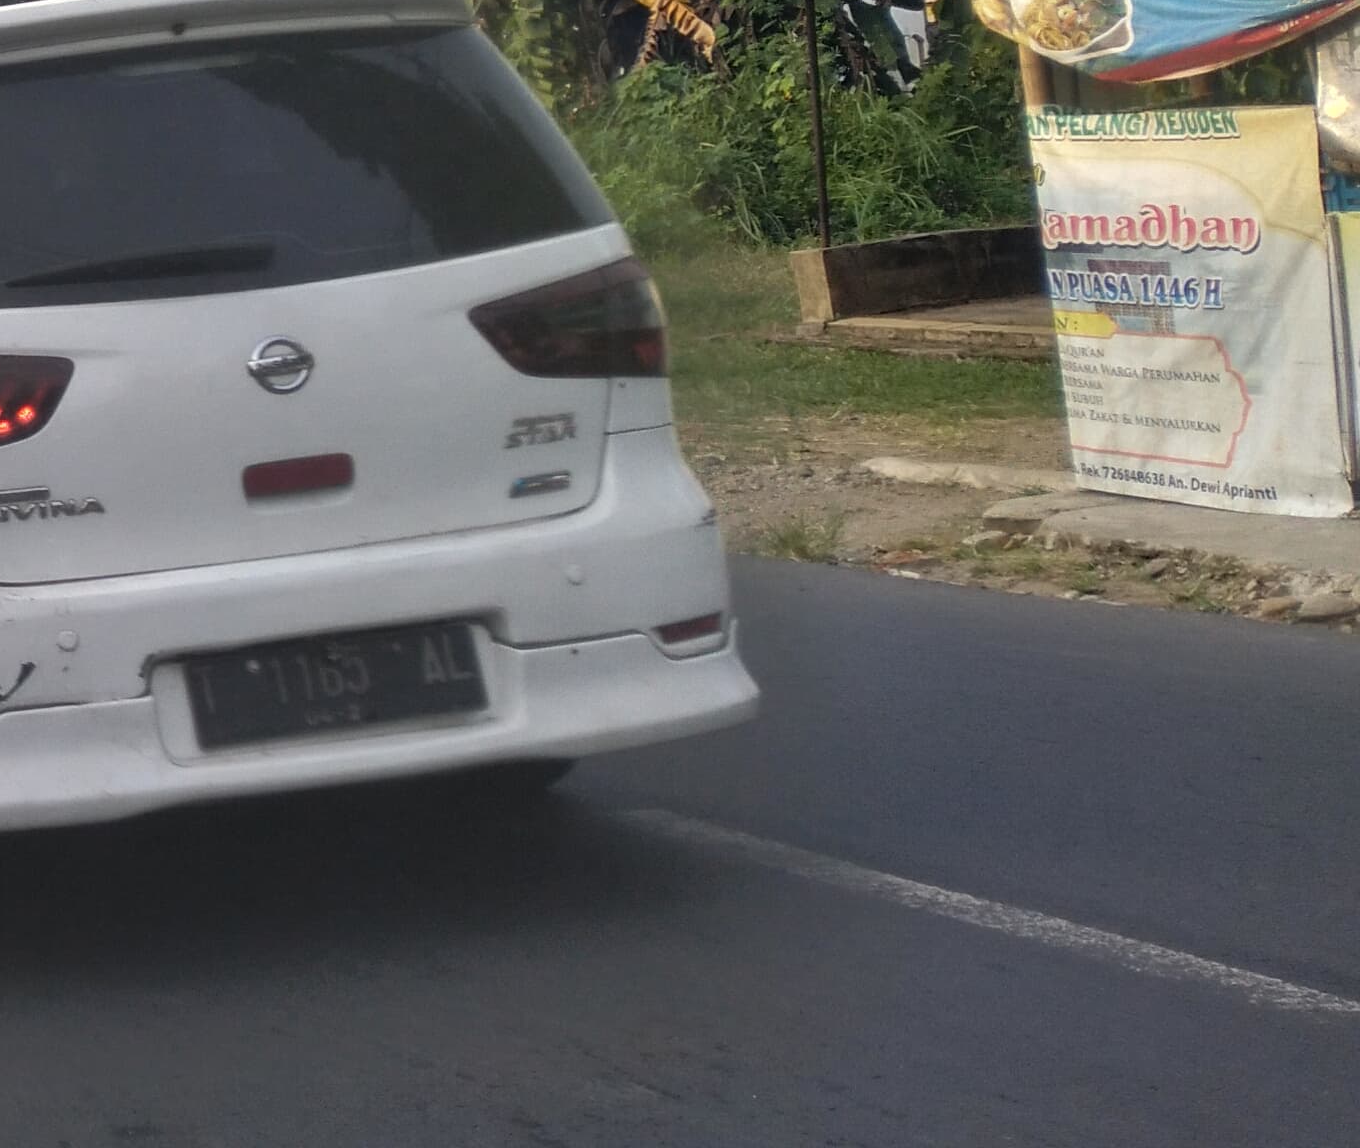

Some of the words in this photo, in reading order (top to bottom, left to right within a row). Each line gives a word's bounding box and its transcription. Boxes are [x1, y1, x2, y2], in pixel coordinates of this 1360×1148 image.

[1054, 111, 1150, 138] PELANGI
[1066, 272, 1133, 303] PUASA
[1140, 276, 1201, 307] 1446
[1203, 278, 1222, 308] H
[1190, 477, 1221, 494] Dewi
[1223, 482, 1278, 501] Aprianti
